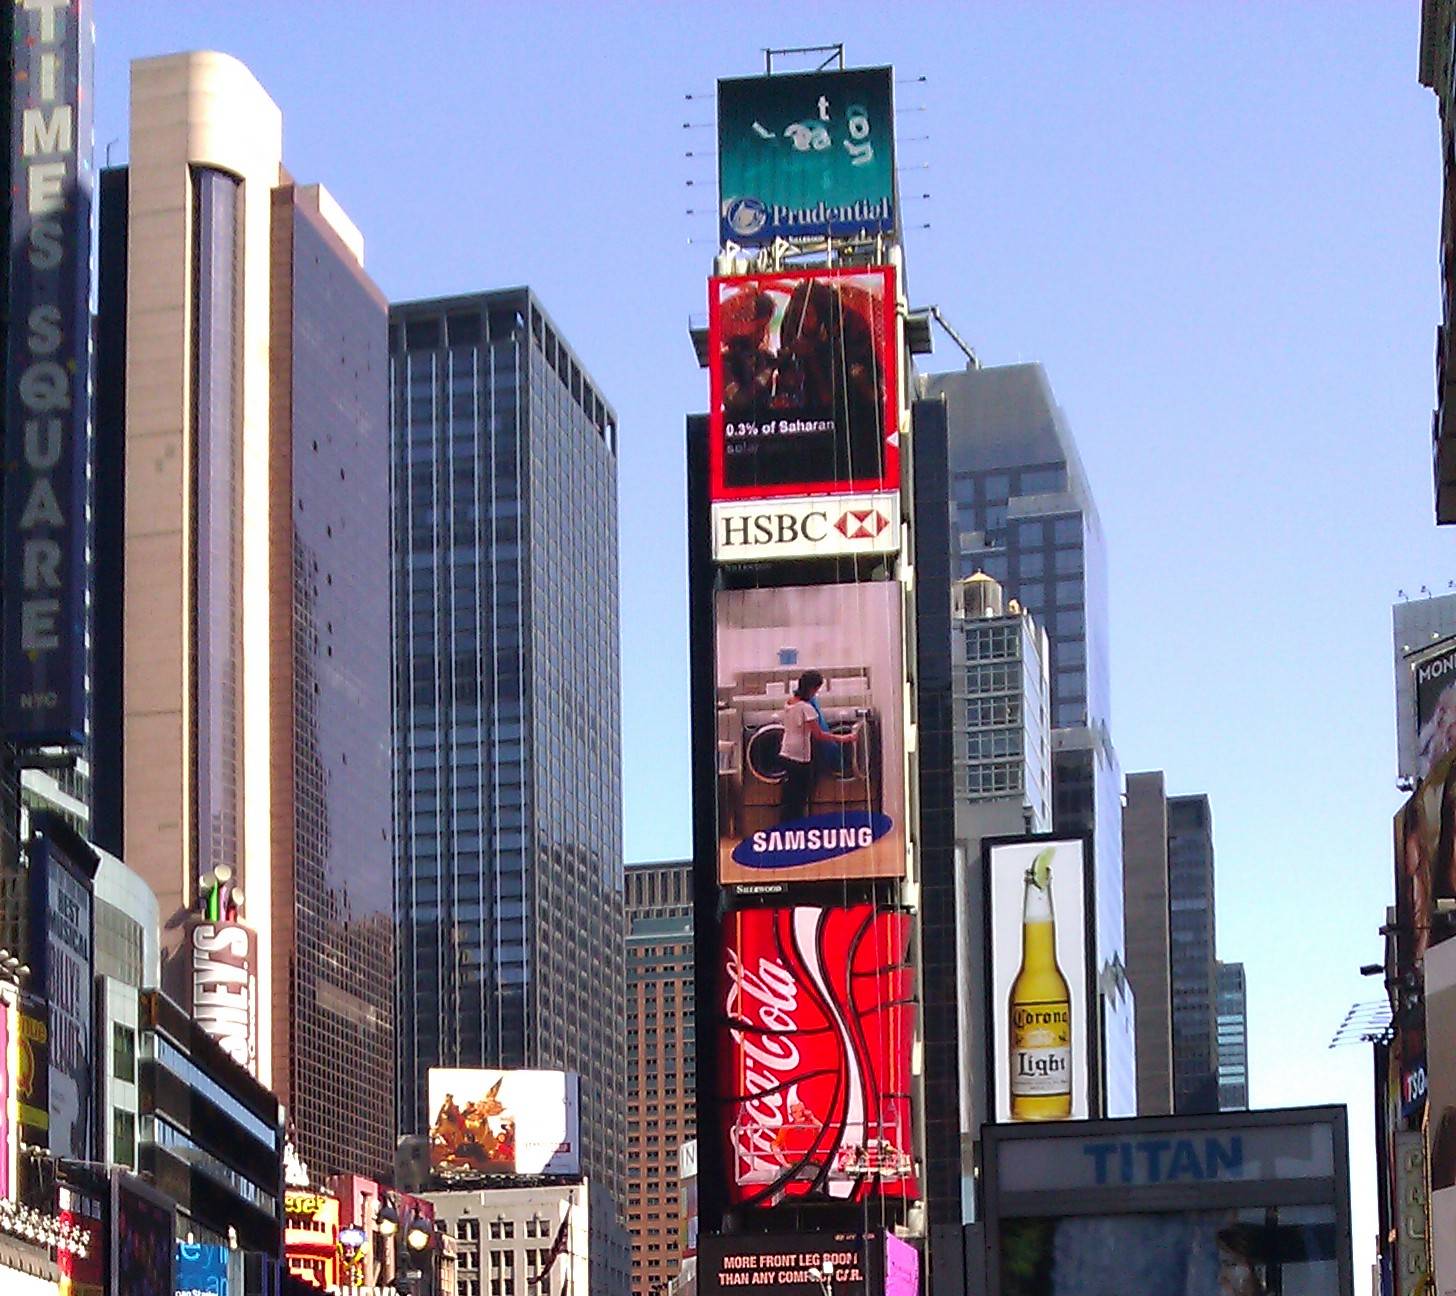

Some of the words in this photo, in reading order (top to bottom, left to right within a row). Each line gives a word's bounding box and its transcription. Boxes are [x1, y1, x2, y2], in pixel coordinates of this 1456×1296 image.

[23, 0, 72, 271] TIMES
[772, 196, 888, 226] Prudential
[726, 421, 759, 437] 0.3%
[762, 420, 777, 435] of
[779, 418, 835, 434] Saharan
[18, 305, 70, 653] SQUARE
[721, 511, 828, 547] HSBC
[752, 827, 873, 852] SAMSUNG
[1084, 1135, 1244, 1186] TITAN
[723, 1255, 757, 1270] MORE
[759, 1254, 796, 1268] FRONT
[799, 1253, 820, 1267] LEG
[719, 1272, 749, 1286] THAN
[752, 1271, 776, 1284] ANY
